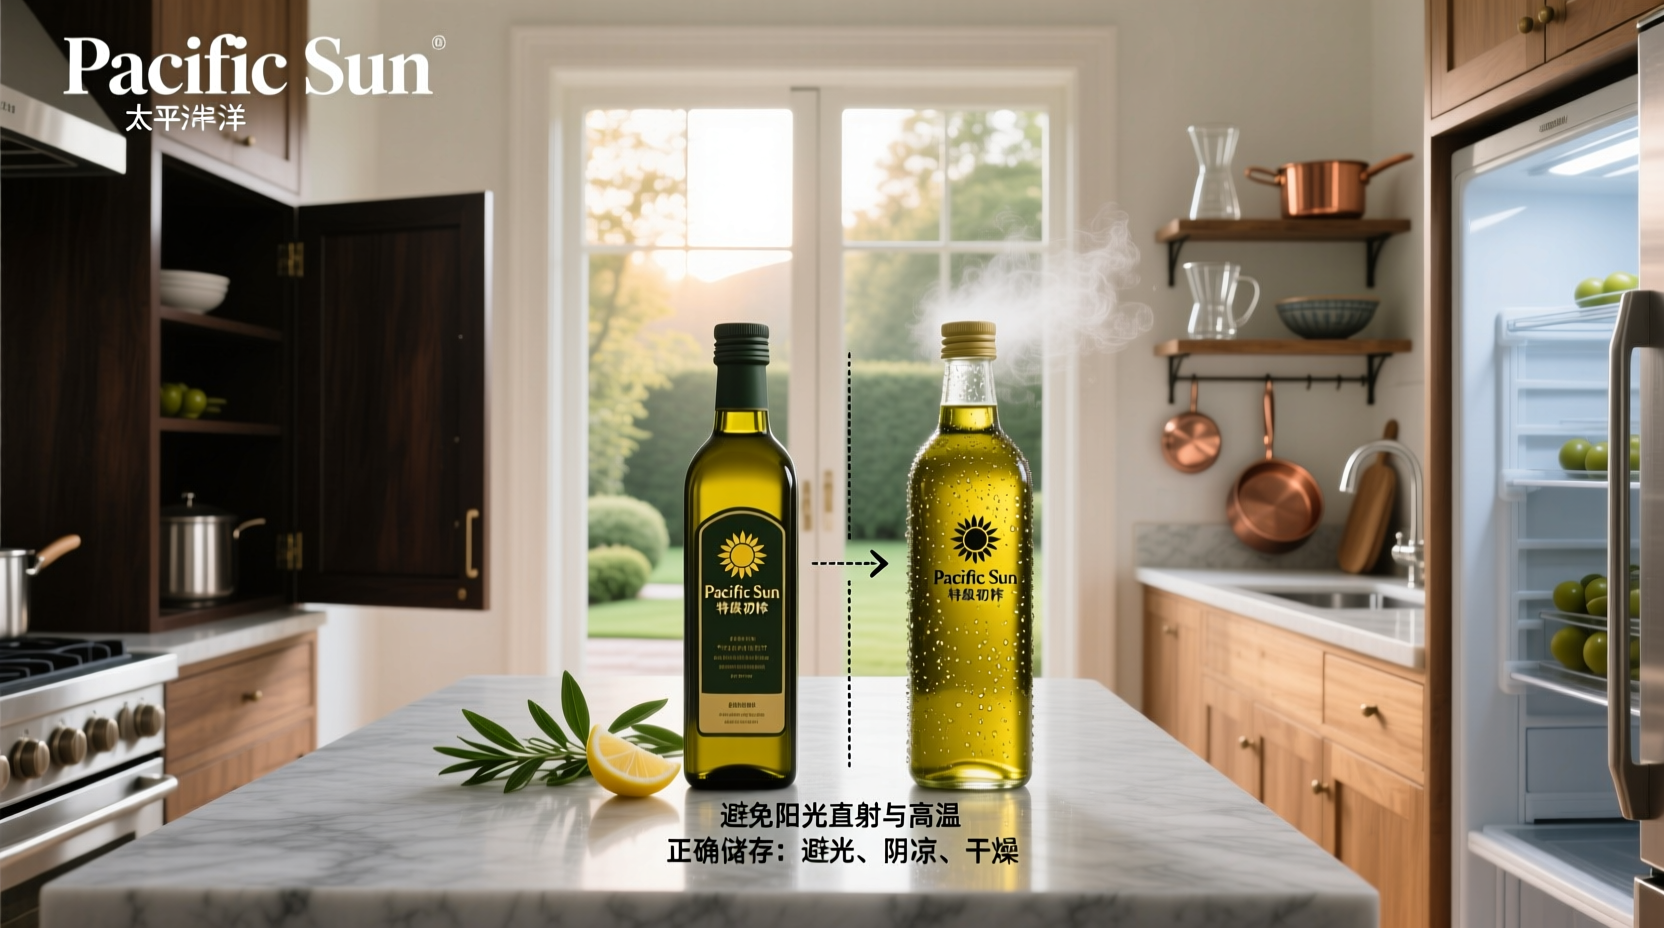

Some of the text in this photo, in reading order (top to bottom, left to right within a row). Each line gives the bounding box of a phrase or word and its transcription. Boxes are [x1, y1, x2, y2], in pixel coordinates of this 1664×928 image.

[933, 569, 1018, 585] Pacific Sun
[704, 584, 780, 599] Pacific Sun
